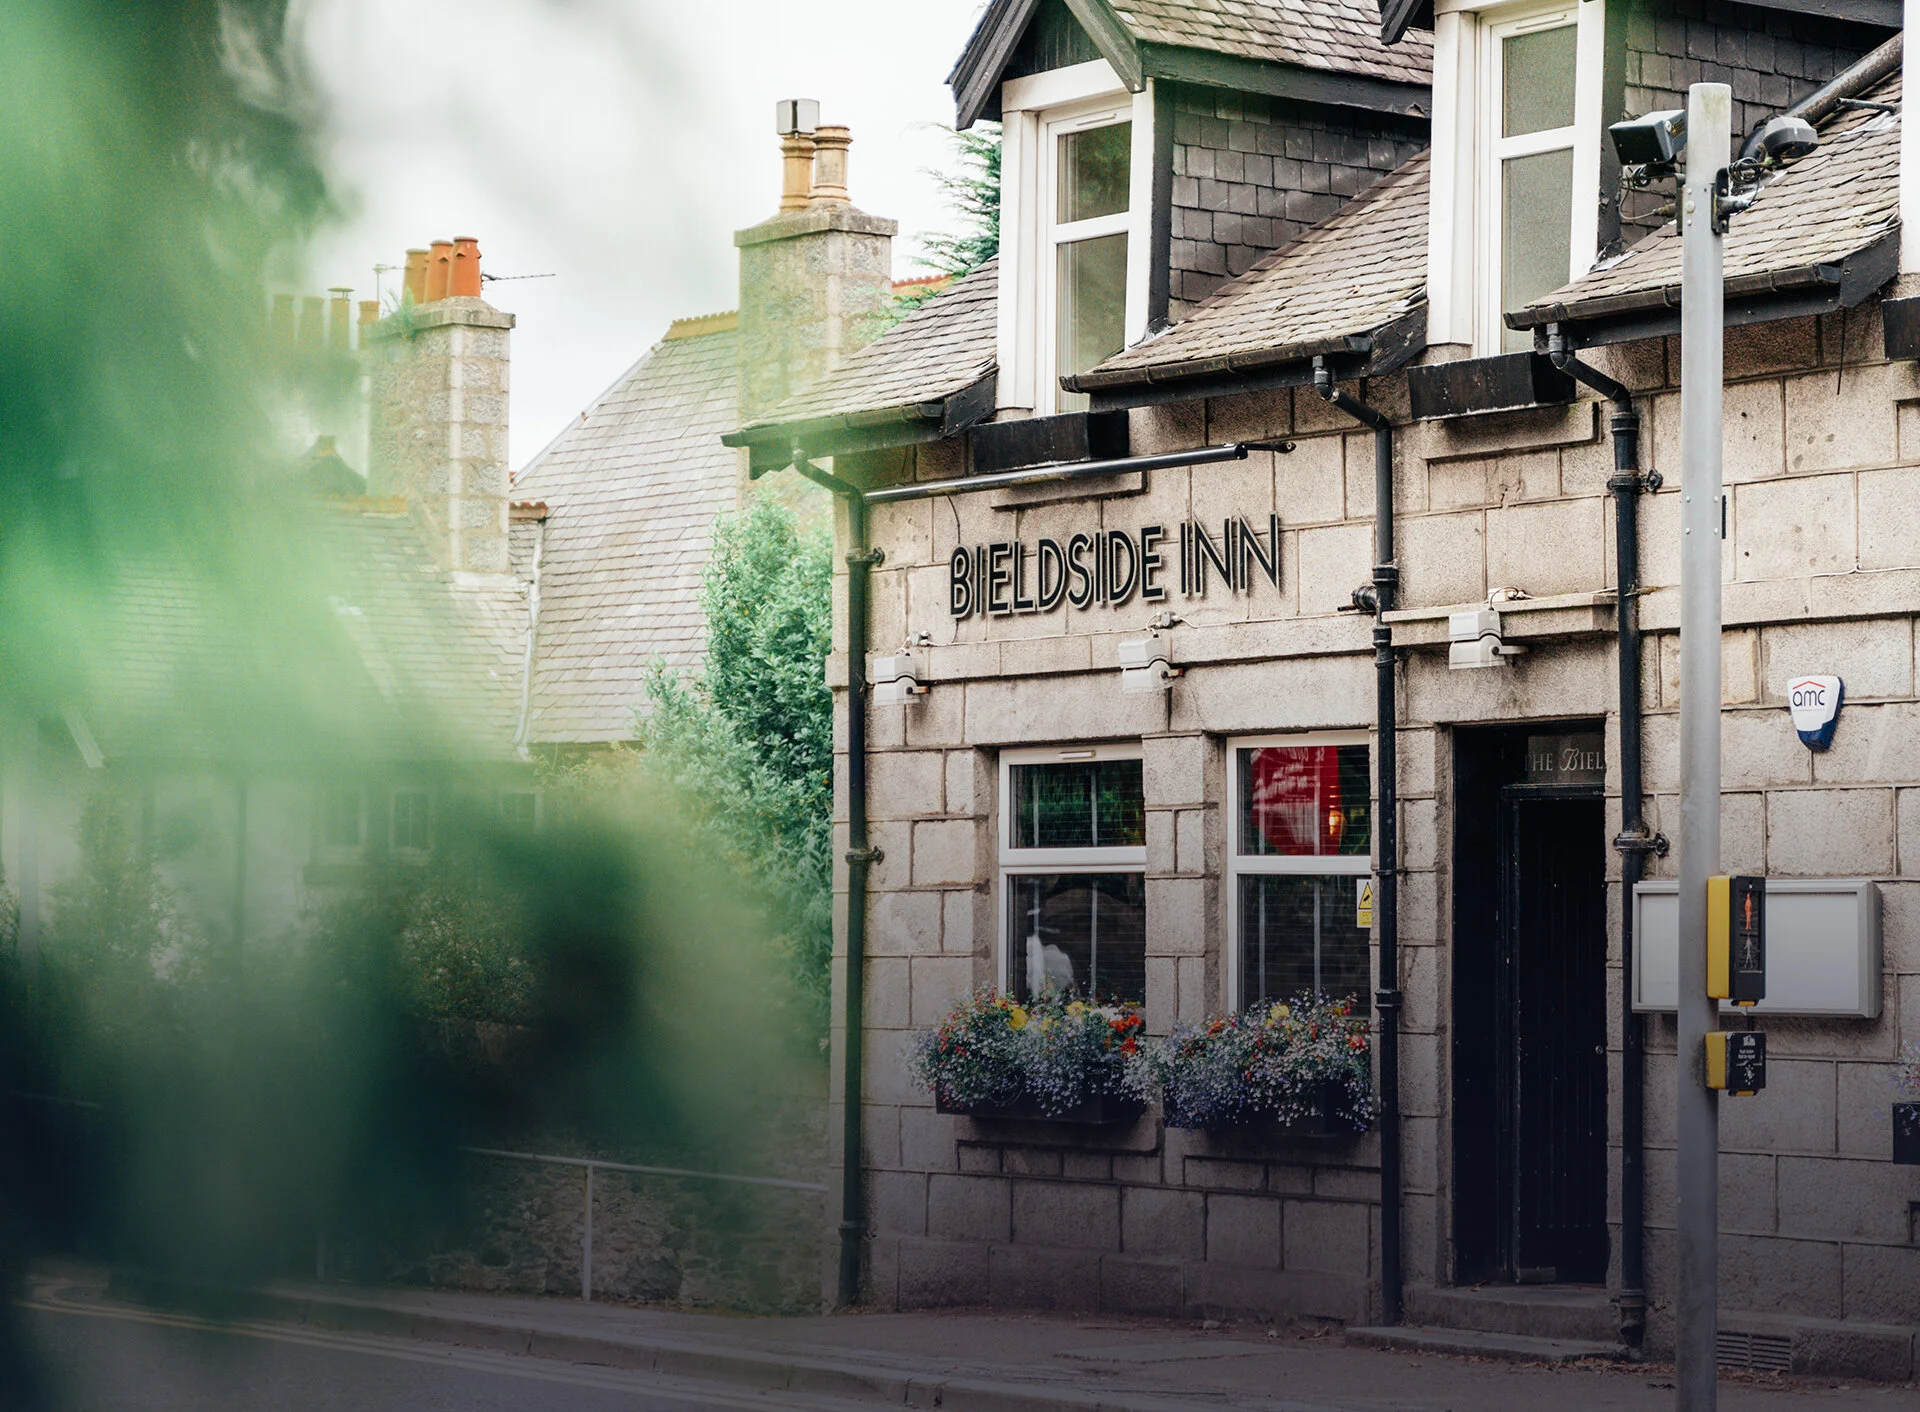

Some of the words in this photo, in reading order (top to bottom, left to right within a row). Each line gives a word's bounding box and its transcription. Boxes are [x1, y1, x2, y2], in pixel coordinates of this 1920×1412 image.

[950, 521, 1166, 619] BIELDSIDE
[1179, 509, 1280, 597] INN
[1792, 689, 1826, 707] amc
[1560, 747, 1607, 771] BIEL
